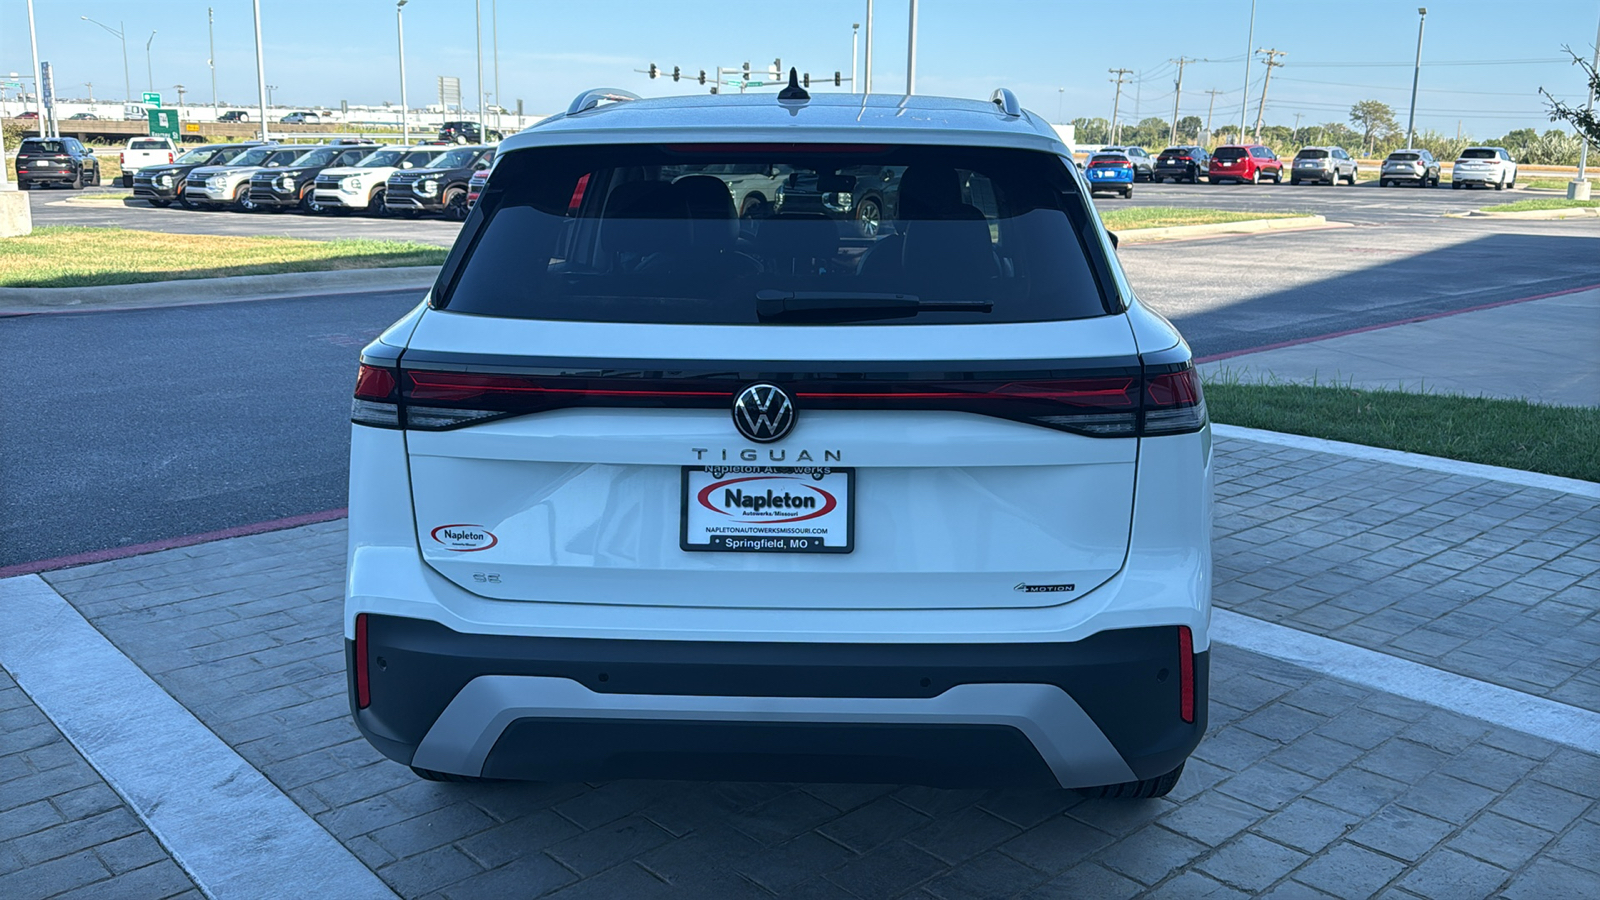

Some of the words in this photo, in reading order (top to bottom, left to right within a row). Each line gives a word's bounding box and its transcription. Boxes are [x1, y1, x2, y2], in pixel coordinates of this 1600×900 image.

[691, 448, 841, 462] TIGUAN
[764, 466, 831, 475] Awerks
[724, 488, 816, 511] Napleton
[444, 529, 484, 540] Napleton
[705, 526, 828, 535] NAPLETONAUTOWERKSMISSOURI.COM
[725, 538, 787, 550] Springfield,
[790, 539, 808, 548] MO
[1013, 582, 1073, 592] 4MOTION
